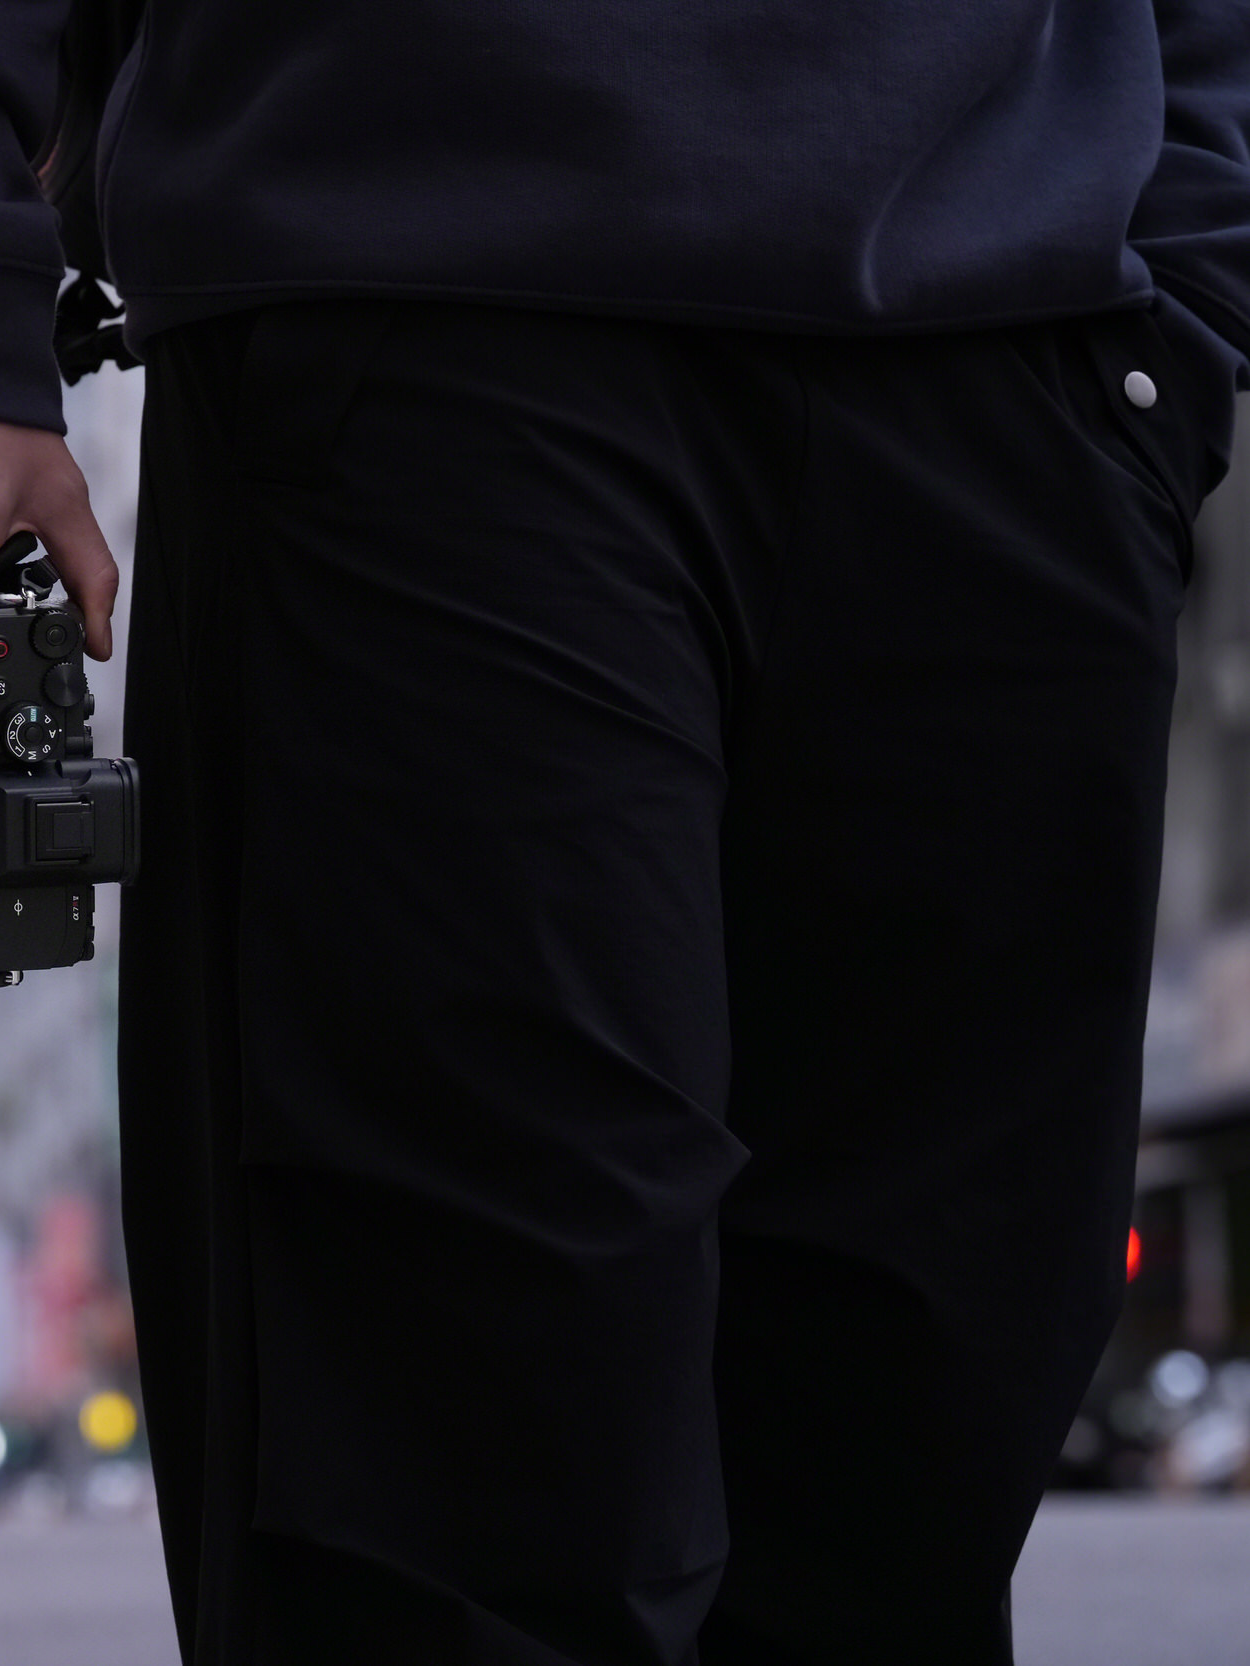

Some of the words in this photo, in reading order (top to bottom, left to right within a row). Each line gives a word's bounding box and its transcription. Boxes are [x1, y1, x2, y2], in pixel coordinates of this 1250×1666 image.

[14, 716, 22, 725] 3
[44, 714, 52, 724] P
[10, 730, 16, 740] 2
[48, 729, 57, 739] A
[14, 745, 22, 753] 1
[42, 744, 51, 754] S
[27, 750, 37, 760] M
